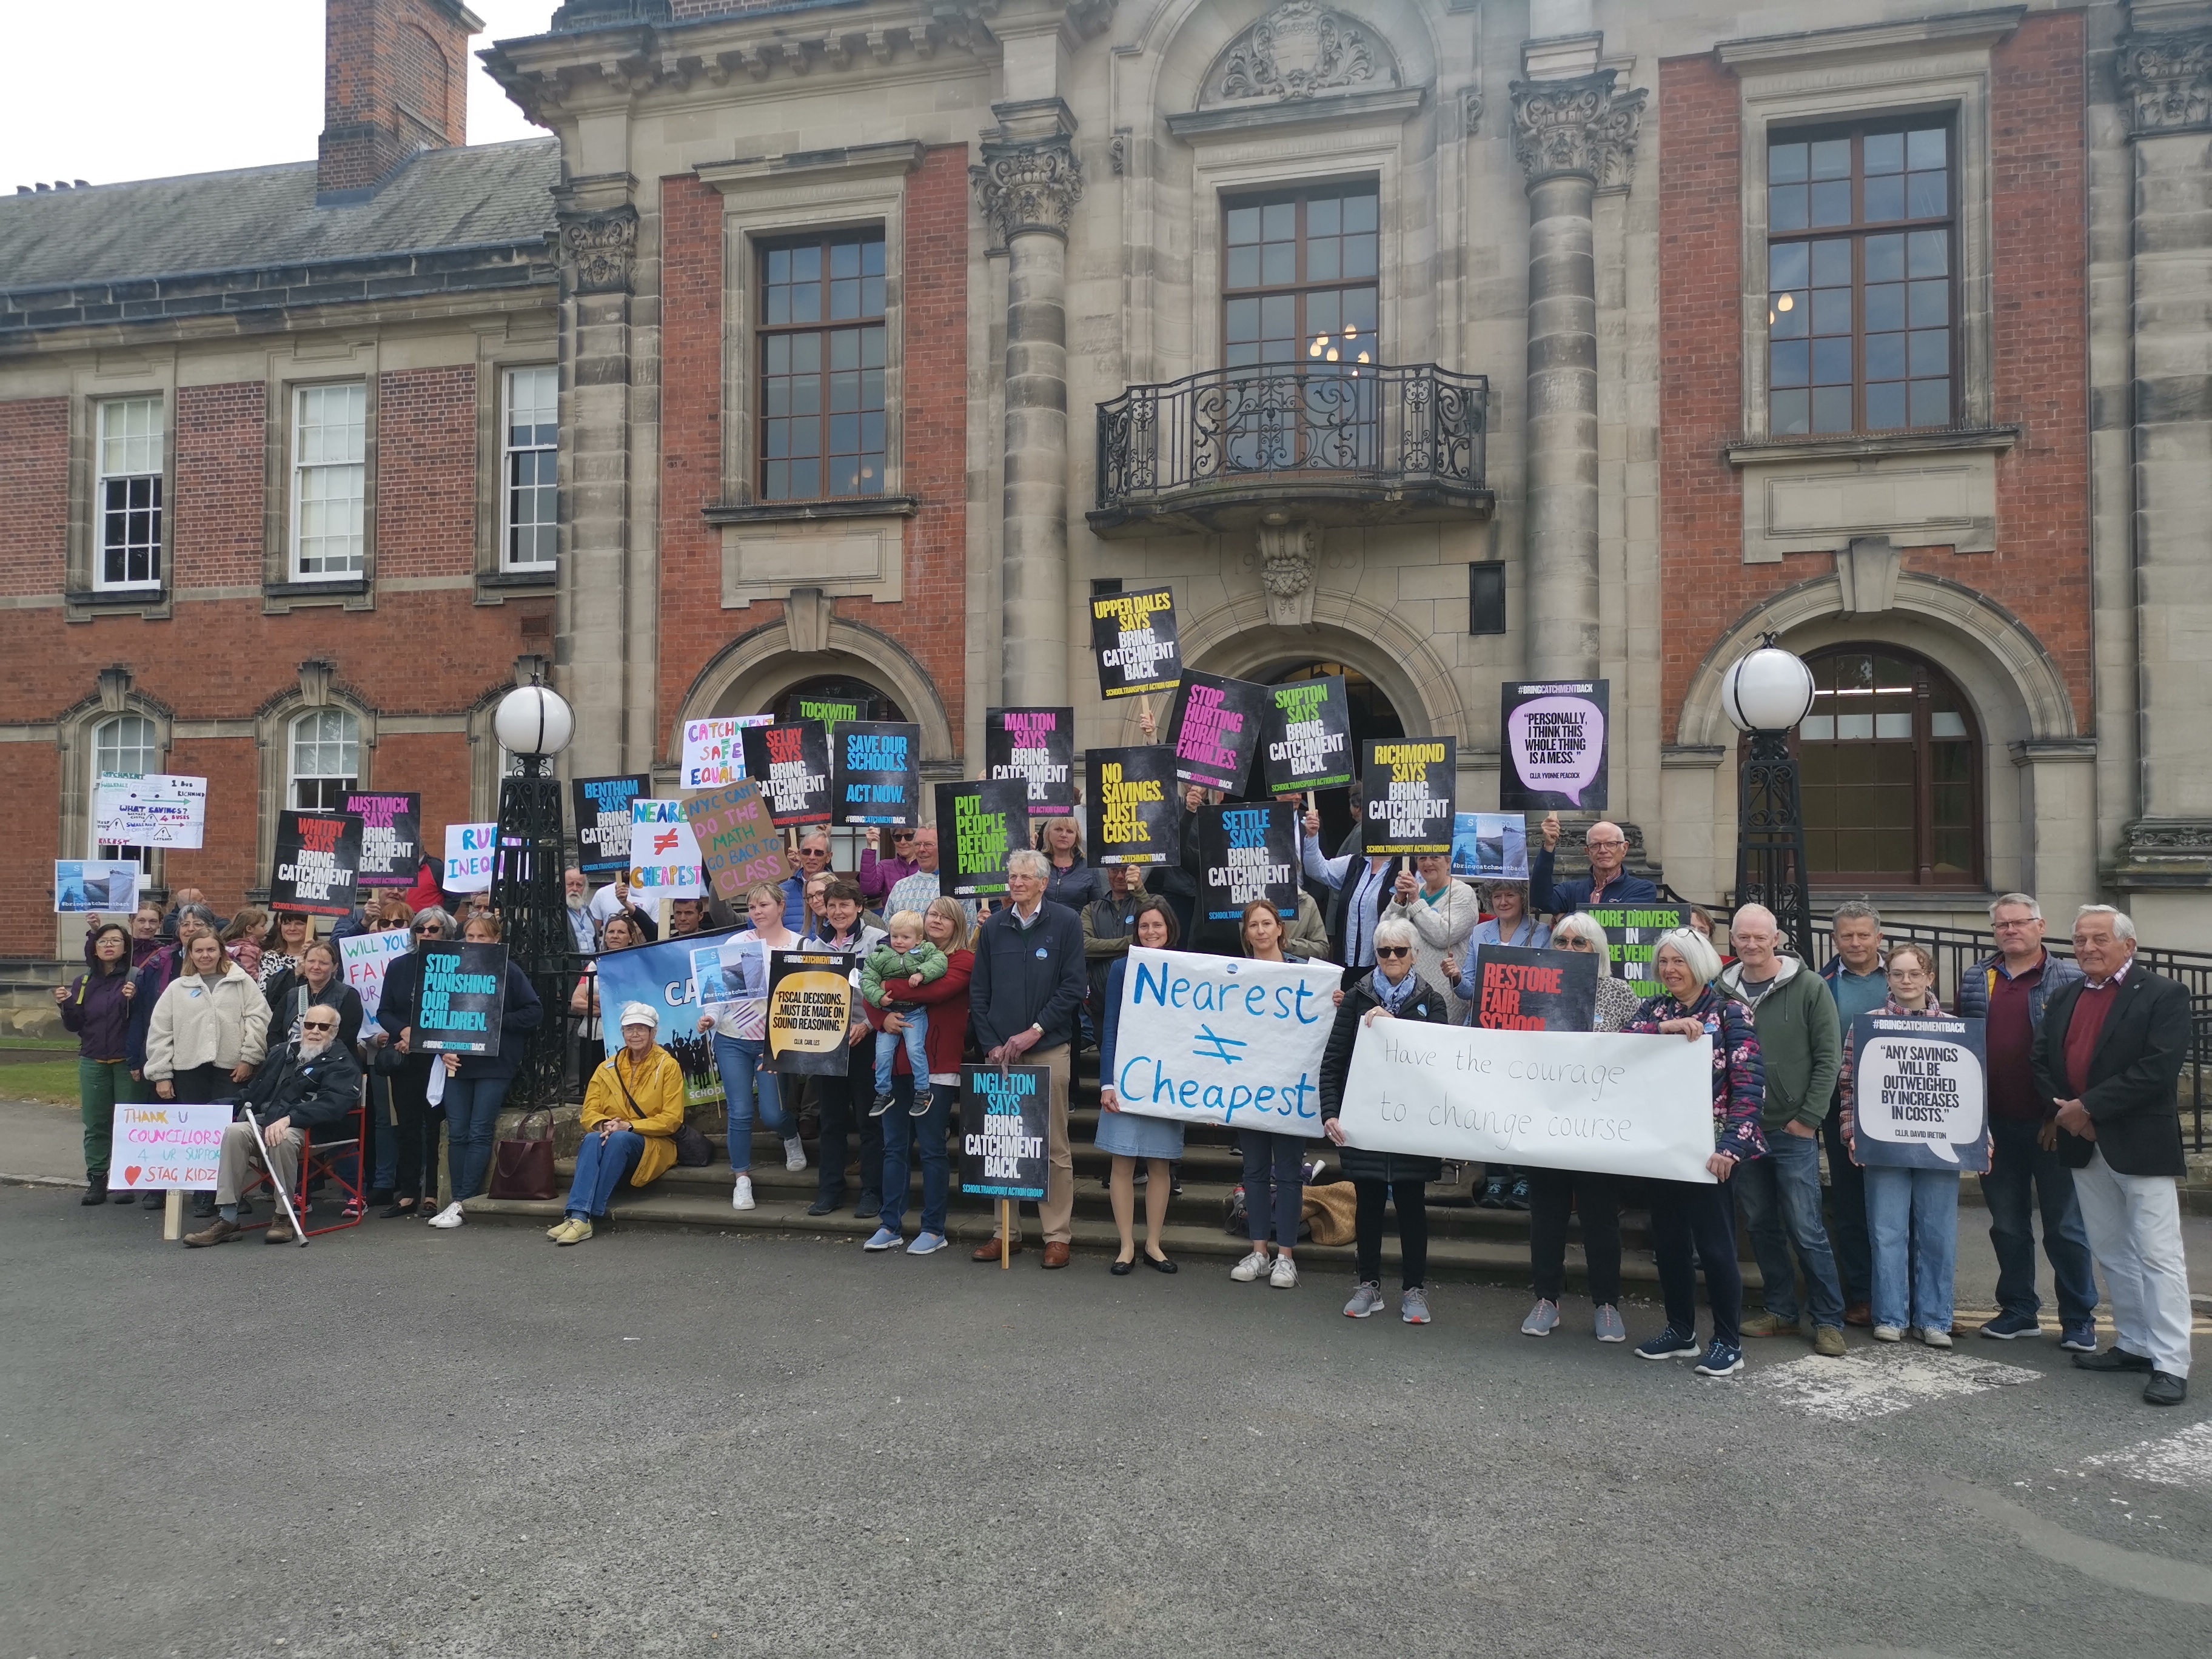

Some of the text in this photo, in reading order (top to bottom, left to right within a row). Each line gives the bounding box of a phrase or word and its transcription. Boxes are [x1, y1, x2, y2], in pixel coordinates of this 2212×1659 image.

[1094, 592, 1171, 618] UPPER DALES
[1119, 612, 1150, 631] SAYS
[1118, 628, 1156, 648] BRING
[1102, 642, 1174, 667] CATCHMENT
[1124, 660, 1158, 681] BACK.
[1188, 684, 1225, 708] STOP
[1275, 683, 1328, 709] SKIPTON
[1518, 684, 1593, 694] #BRINGCATCHMENTBACK
[800, 702, 857, 720] TOCKWITH
[1184, 702, 1244, 733] HURTING
[1287, 703, 1319, 724] SAYS
[1005, 712, 1056, 731] MALTON
[1286, 719, 1324, 742] BRING
[1529, 725, 1583, 738] I THINK THIS
[766, 728, 802, 748] SELBY
[1014, 730, 1046, 748] SAYS
[1180, 720, 1222, 747] RURAL
[771, 745, 802, 763] SAYS
[848, 735, 879, 753] SAVE
[881, 736, 907, 754] OUR
[1176, 739, 1237, 770] FAMILIES.
[1269, 733, 1344, 761] CATCHMENT
[1375, 743, 1445, 764] RICHMOND
[1525, 739, 1586, 751] WHOLE THING
[846, 752, 908, 771] SCHOOLS.
[1011, 748, 1049, 765] BRING
[1290, 754, 1327, 776] BACK.
[1530, 752, 1538, 764] IS
[1540, 752, 1546, 764] A
[769, 760, 806, 780] BRING
[993, 765, 1068, 783] CATCHMENT
[1102, 763, 1122, 783] NO
[1392, 762, 1426, 782] SAYS
[585, 780, 638, 799] BENTHAM
[846, 784, 905, 803] ACT NOW.
[1102, 780, 1164, 803] SAVINGS.
[1389, 781, 1429, 800] BRING
[347, 796, 409, 813] AUSTWICK
[598, 796, 628, 812] SAYS
[633, 802, 689, 823] NEARE
[689, 796, 721, 817] NYC
[774, 794, 809, 813] BACK.
[954, 795, 982, 816] PUT
[1102, 802, 1138, 823] JUST
[1369, 799, 1449, 819] CATCHMENT
[298, 817, 346, 837] WHITBY
[363, 812, 393, 827] SAYS
[597, 810, 631, 828] BRING
[695, 802, 758, 839] DO THE
[956, 812, 1007, 835] PEOPLE
[1222, 809, 1270, 830] SETTLE
[1389, 819, 1427, 837] BACK.
[713, 824, 756, 851] MATH
[1103, 821, 1151, 843] COSTS.
[1230, 828, 1265, 848] SAYS
[304, 834, 335, 853] SAYS
[362, 842, 414, 857] TCHMENT
[957, 832, 1008, 854] BEFORE
[297, 850, 335, 868] BRING
[707, 838, 780, 871] GO BACK TO
[958, 852, 1006, 874] PARTY.
[1227, 846, 1269, 867] BRING
[278, 864, 353, 886] CATCHMENT
[359, 857, 393, 873] BACK.
[720, 855, 781, 891] CLASS
[630, 865, 702, 889] CHEAPEST
[1208, 865, 1290, 886] CATCHMENT
[296, 882, 330, 900] BACK.
[1626, 910, 1680, 927] DRIVERS
[1626, 928, 1639, 944] IN
[343, 939, 379, 958] WILL
[426, 953, 460, 973] STOP
[1624, 962, 1643, 979] ON
[424, 973, 496, 994] PUNISHING
[1483, 963, 1563, 994] RESTORE
[422, 991, 449, 1011] OUR
[1133, 962, 1319, 1024] Nearest
[1481, 987, 1521, 1014] FAIR
[420, 1010, 487, 1031] CHILDREN.
[802, 1005, 810, 1016] BE
[811, 1006, 831, 1018] MADE
[834, 1007, 844, 1018] ON
[773, 1017, 797, 1028] SOUND
[1872, 1019, 1965, 1033] #BRINGCATCHMENTBACK
[1910, 1046, 1958, 1062] SAVINGS
[1384, 1039, 1625, 1102] Have the courage
[1899, 1061, 1941, 1076] WILL BE
[973, 1073, 1036, 1095] INGLETON
[1120, 1056, 1316, 1123] Cheapest
[1883, 1075, 1956, 1092] OUTWEIGHED
[987, 1094, 1020, 1116] SAYS
[1882, 1090, 1959, 1108] BY INCREASES
[124, 1108, 188, 1124] THANK U
[1380, 1091, 1633, 1151] to change course
[1892, 1106, 1903, 1119] IN
[984, 1114, 1023, 1137] BRING
[1910, 1130, 1926, 1138] DAVID
[129, 1129, 221, 1145] COUNCILLORS
[965, 1134, 1043, 1159] CATCHMENT
[138, 1147, 220, 1162] 4 UR SUPPOR
[185, 1167, 217, 1182] KIDZ
[985, 1156, 1021, 1179] BACK.
[1008, 1187, 1027, 1196] ACTION
[1027, 1188, 1044, 1197] GROUP
